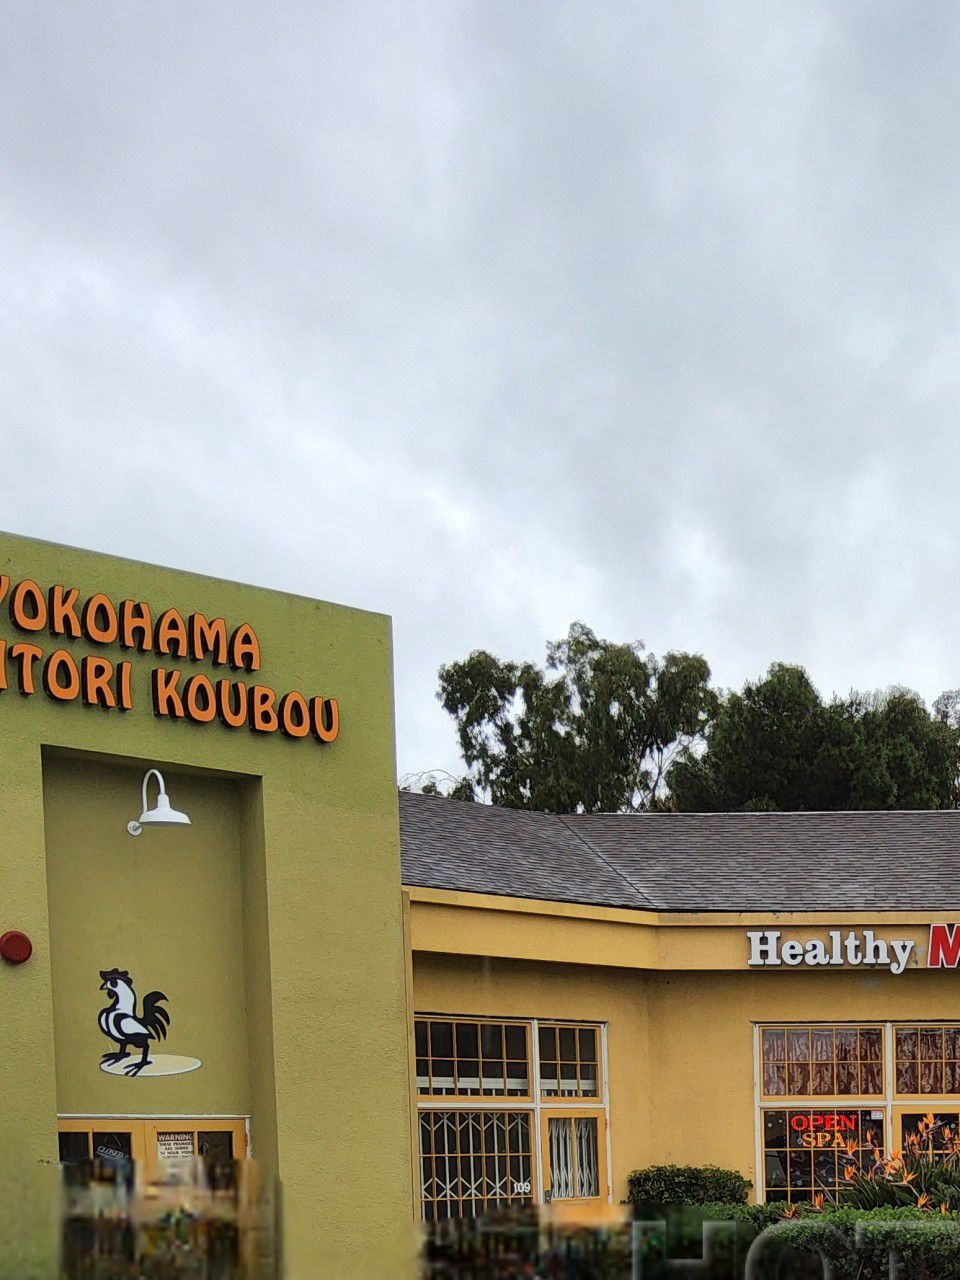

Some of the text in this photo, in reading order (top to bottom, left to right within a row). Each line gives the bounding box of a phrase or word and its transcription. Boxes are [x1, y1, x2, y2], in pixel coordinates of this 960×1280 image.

[152, 668, 340, 743] KOUBOU
[746, 930, 915, 975] Healthy
[791, 1114, 857, 1131] OPEN
[802, 1132, 846, 1147] SPA
[97, 1145, 124, 1158] CLOSED
[513, 1182, 531, 1193] 109
